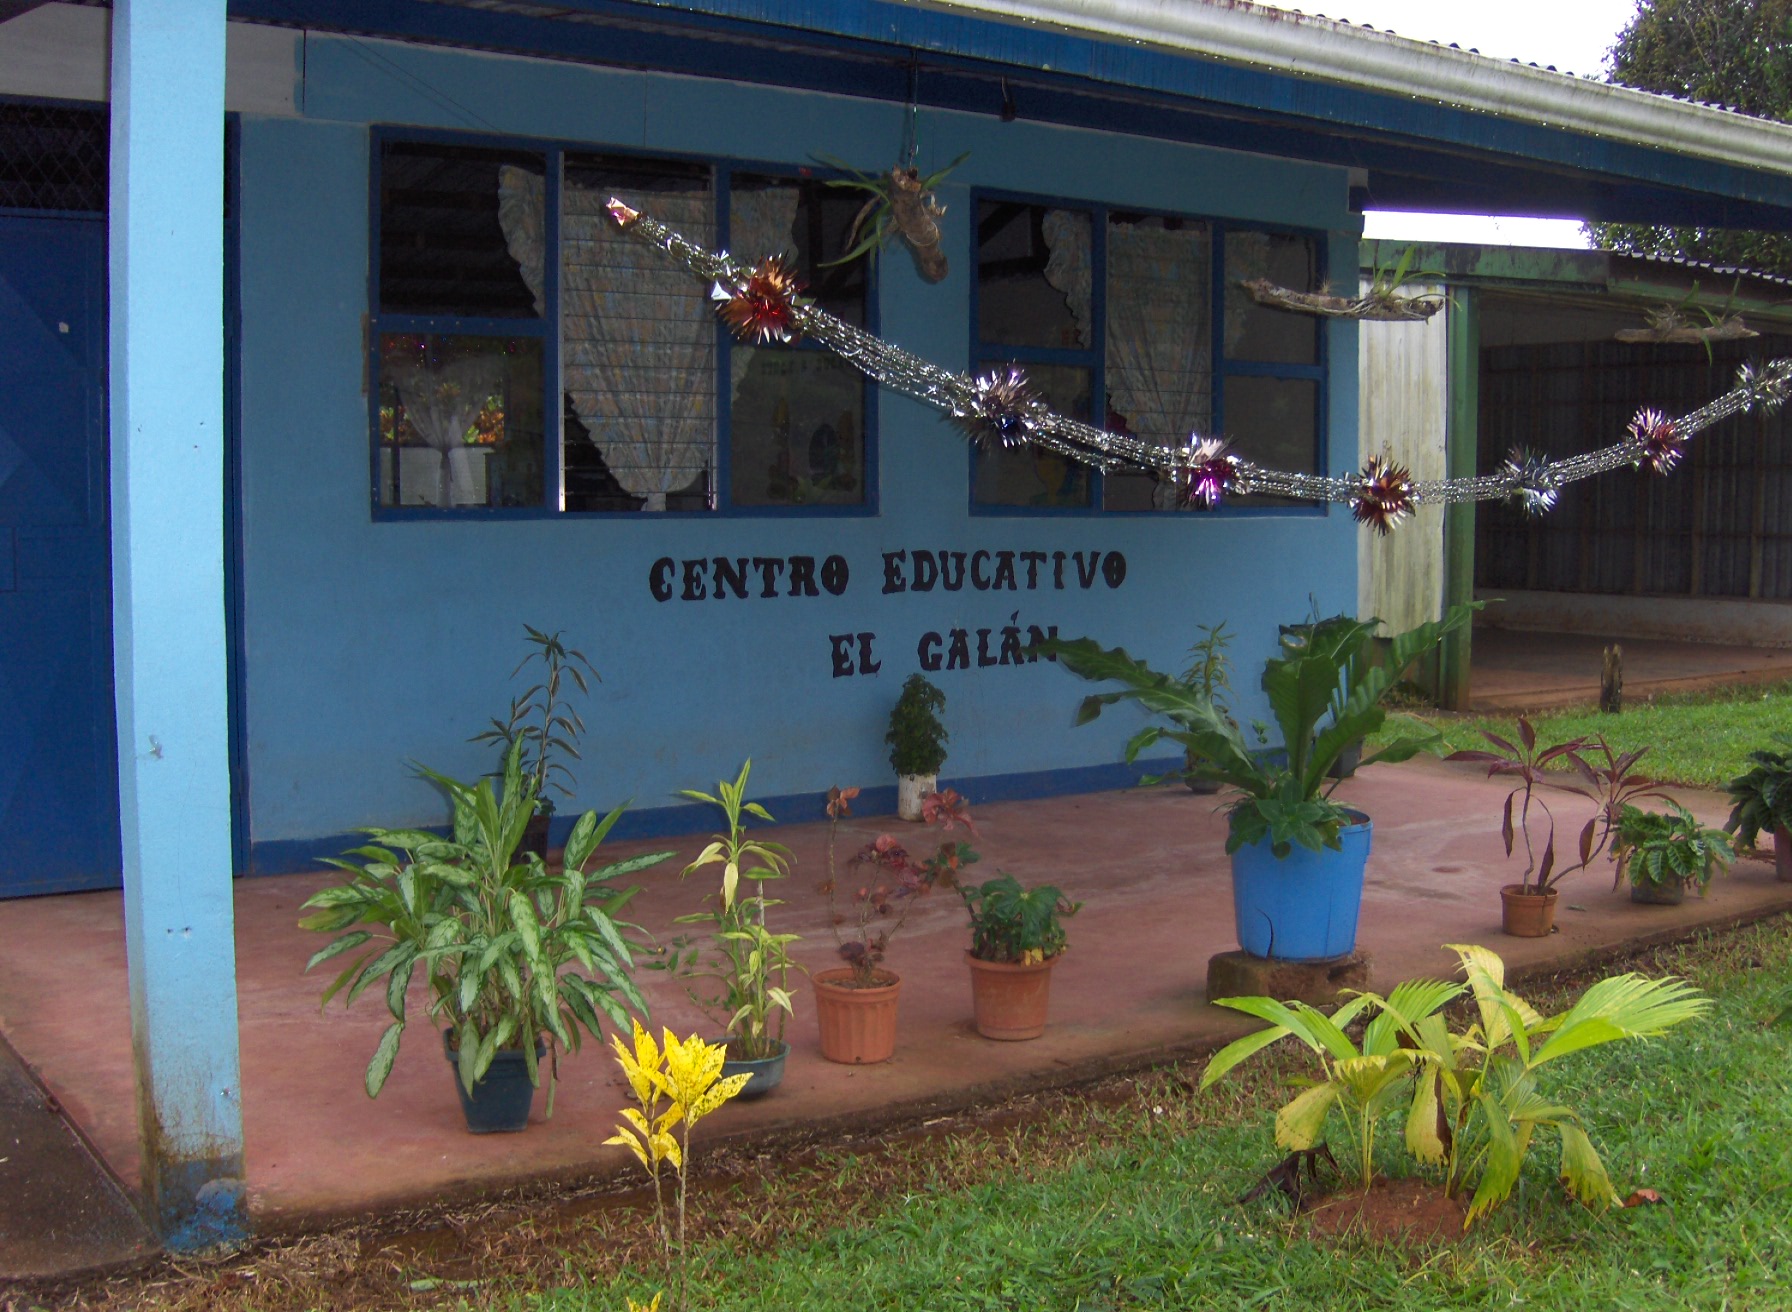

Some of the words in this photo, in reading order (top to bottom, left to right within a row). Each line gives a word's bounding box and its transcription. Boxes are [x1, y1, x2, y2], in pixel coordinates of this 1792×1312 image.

[649, 554, 849, 602] CENTRO
[881, 548, 1127, 594] EDUCATIVO
[829, 632, 882, 678] EL
[917, 610, 1058, 672] GALÁN
